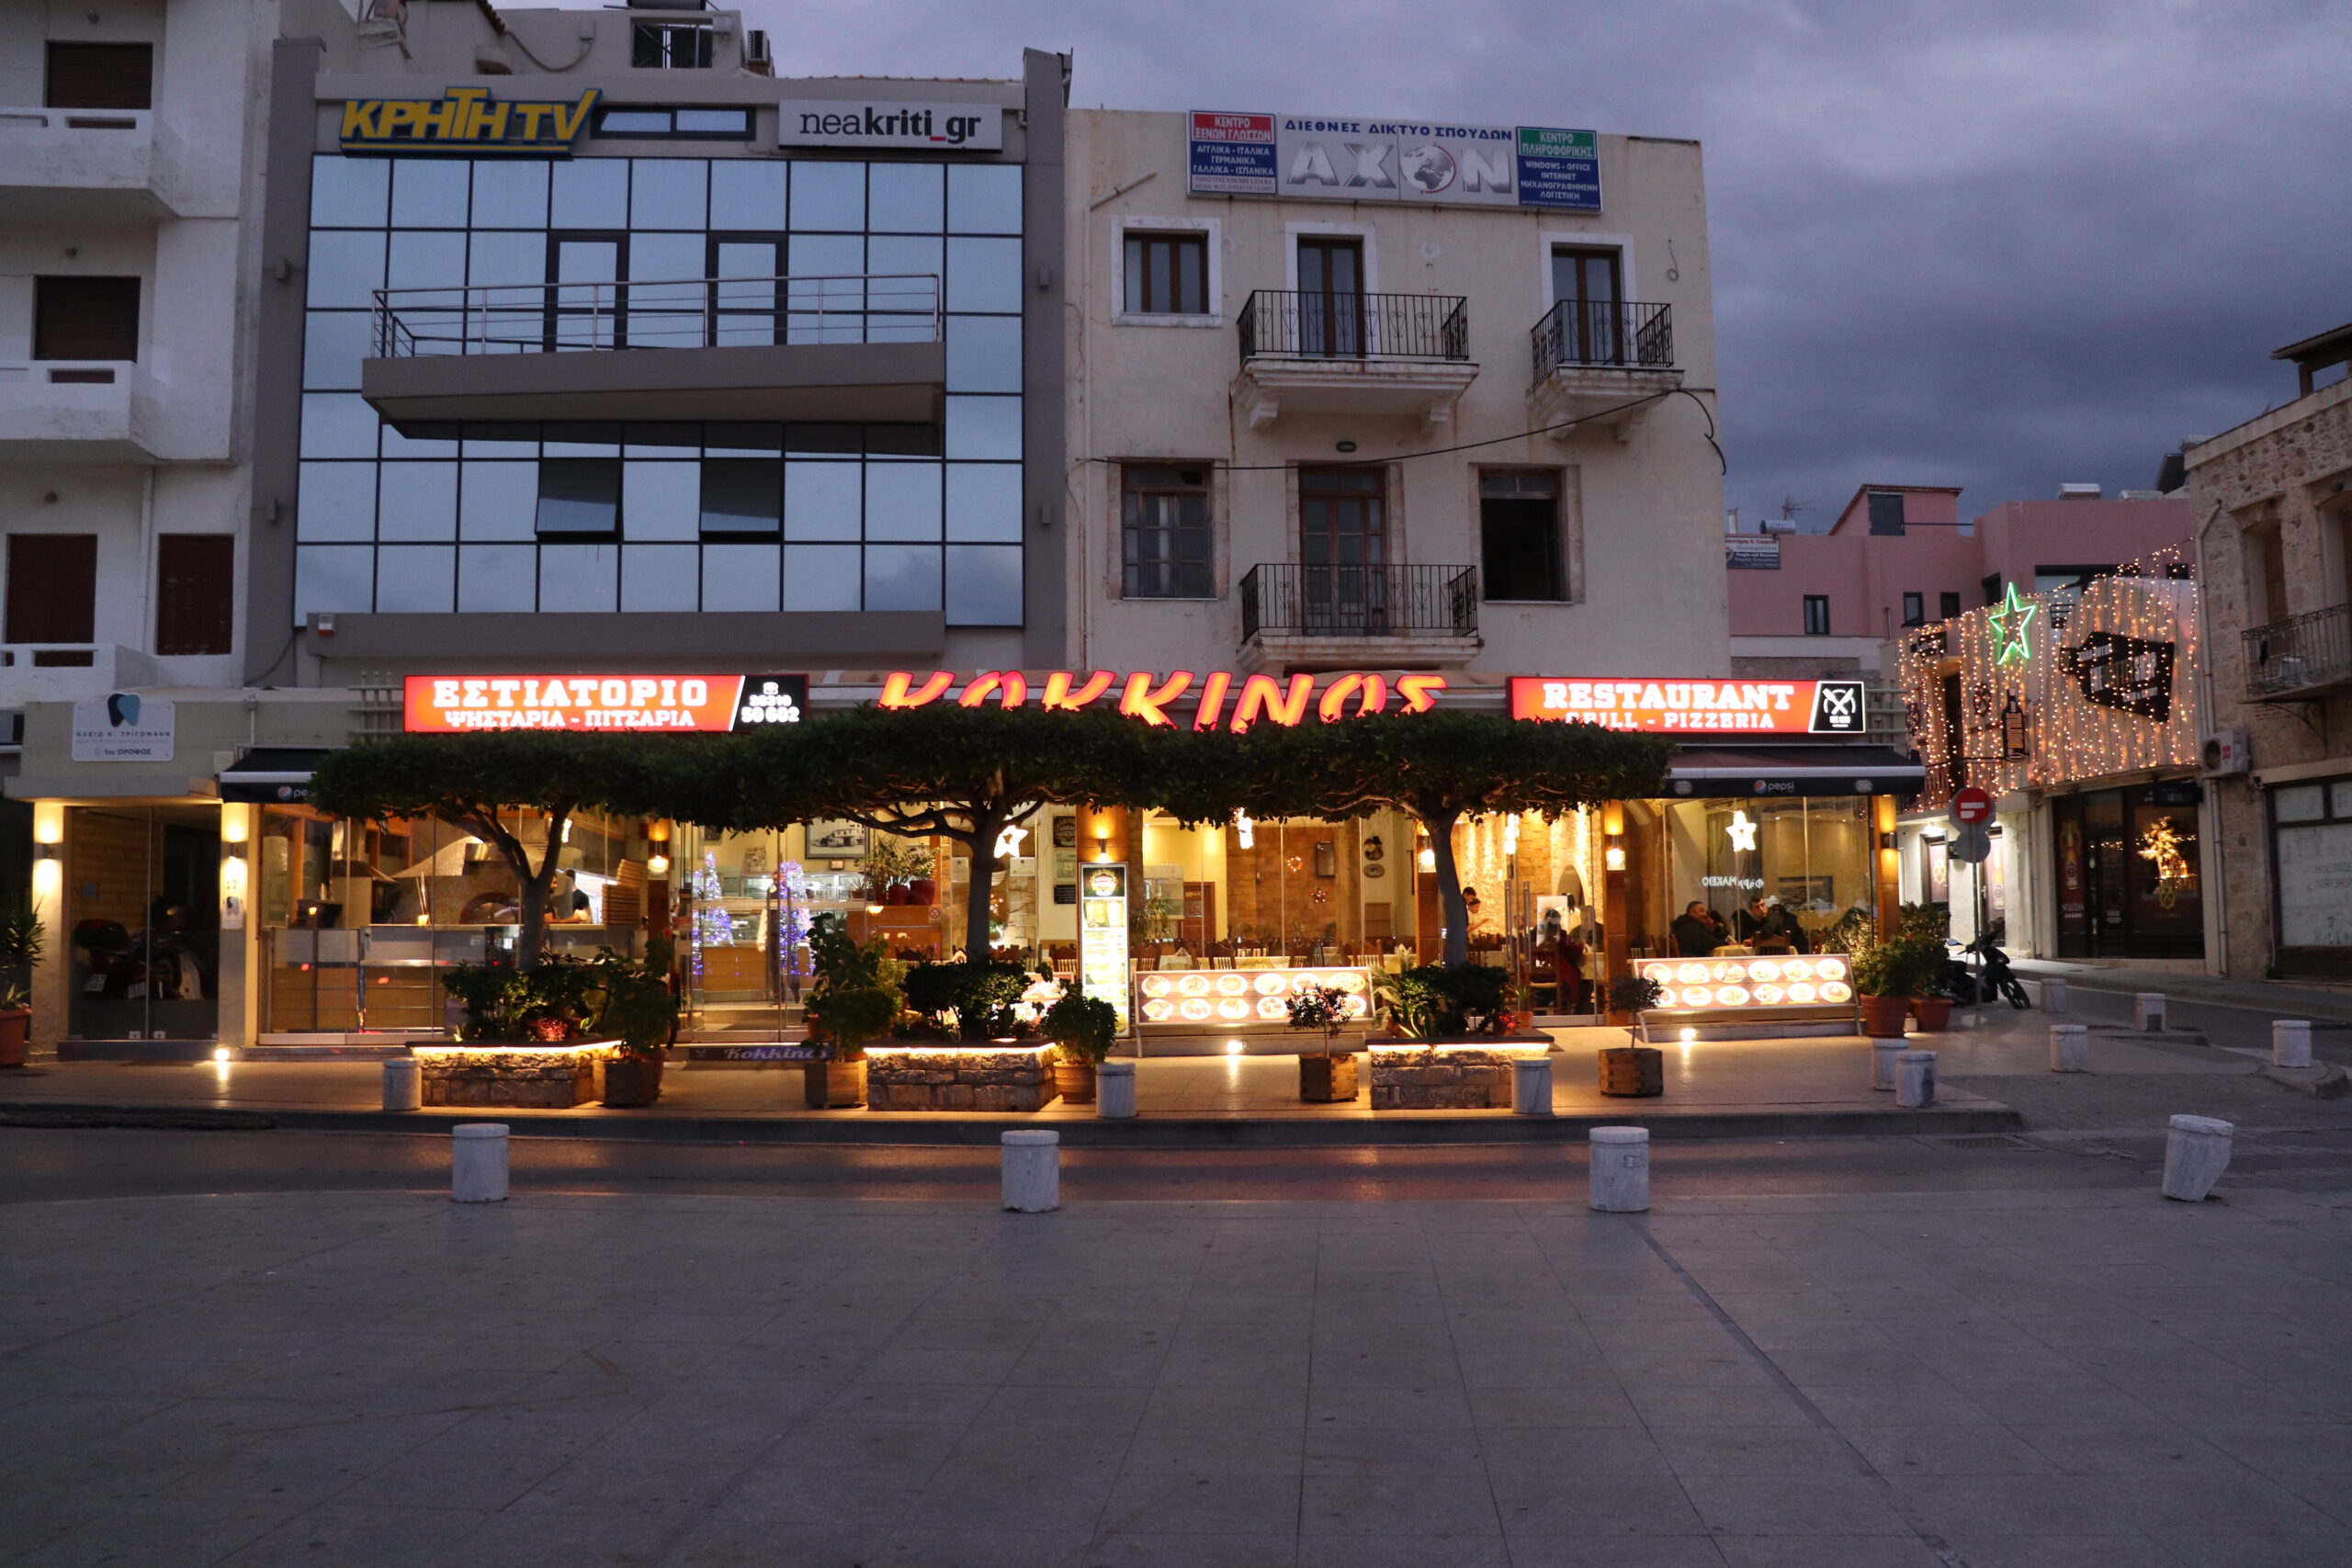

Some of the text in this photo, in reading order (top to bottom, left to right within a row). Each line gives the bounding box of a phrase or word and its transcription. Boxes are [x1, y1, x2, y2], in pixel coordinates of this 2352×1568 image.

[514, 87, 603, 143] TV
[1215, 116, 1250, 128] ΚΕΝΤΡΟ
[1194, 128, 1226, 140] ΞΕΝΩΝ
[1284, 119, 1512, 141] ΔΙΕΘΝΕΣ ΔΙΚΤΥΟ ΣΠΟΥΔΩΝ
[1540, 131, 1574, 143] ΚΕΝΤΡΟ
[1197, 145, 1230, 154] ΑΓΓΛΙΚΑ
[1237, 147, 1270, 155] ΙΤΑΛΙΚΑ
[1522, 143, 1593, 157] ΠΛΗΡΟΦΟΡΙΚΗΣ
[1212, 155, 1256, 164] ΓΕΡΜΑΝΙΚΑ
[1193, 165, 1229, 174] ΓΑΛΛΙΚΑ
[1236, 166, 1274, 175] ΙΣΠΑΝΙΚΑ
[1525, 161, 1560, 170] WINDOWS
[1566, 163, 1591, 172] OFFICE
[1541, 172, 1577, 180] INTERNET
[1540, 190, 1580, 199] ΛΟΓΙΣΤΙΚΗ
[433, 679, 707, 707] ΕΣΤΙΑΤΟΡΙΟ
[1543, 682, 1794, 710] RESTAURANT
[445, 710, 565, 728] ΨΗΣΤΑΡΙΑ
[584, 710, 695, 727] ΠΙΤΣΑΡΙΑ
[1664, 712, 1775, 728] PIZZERIA
[1768, 781, 1794, 792] pepsi
